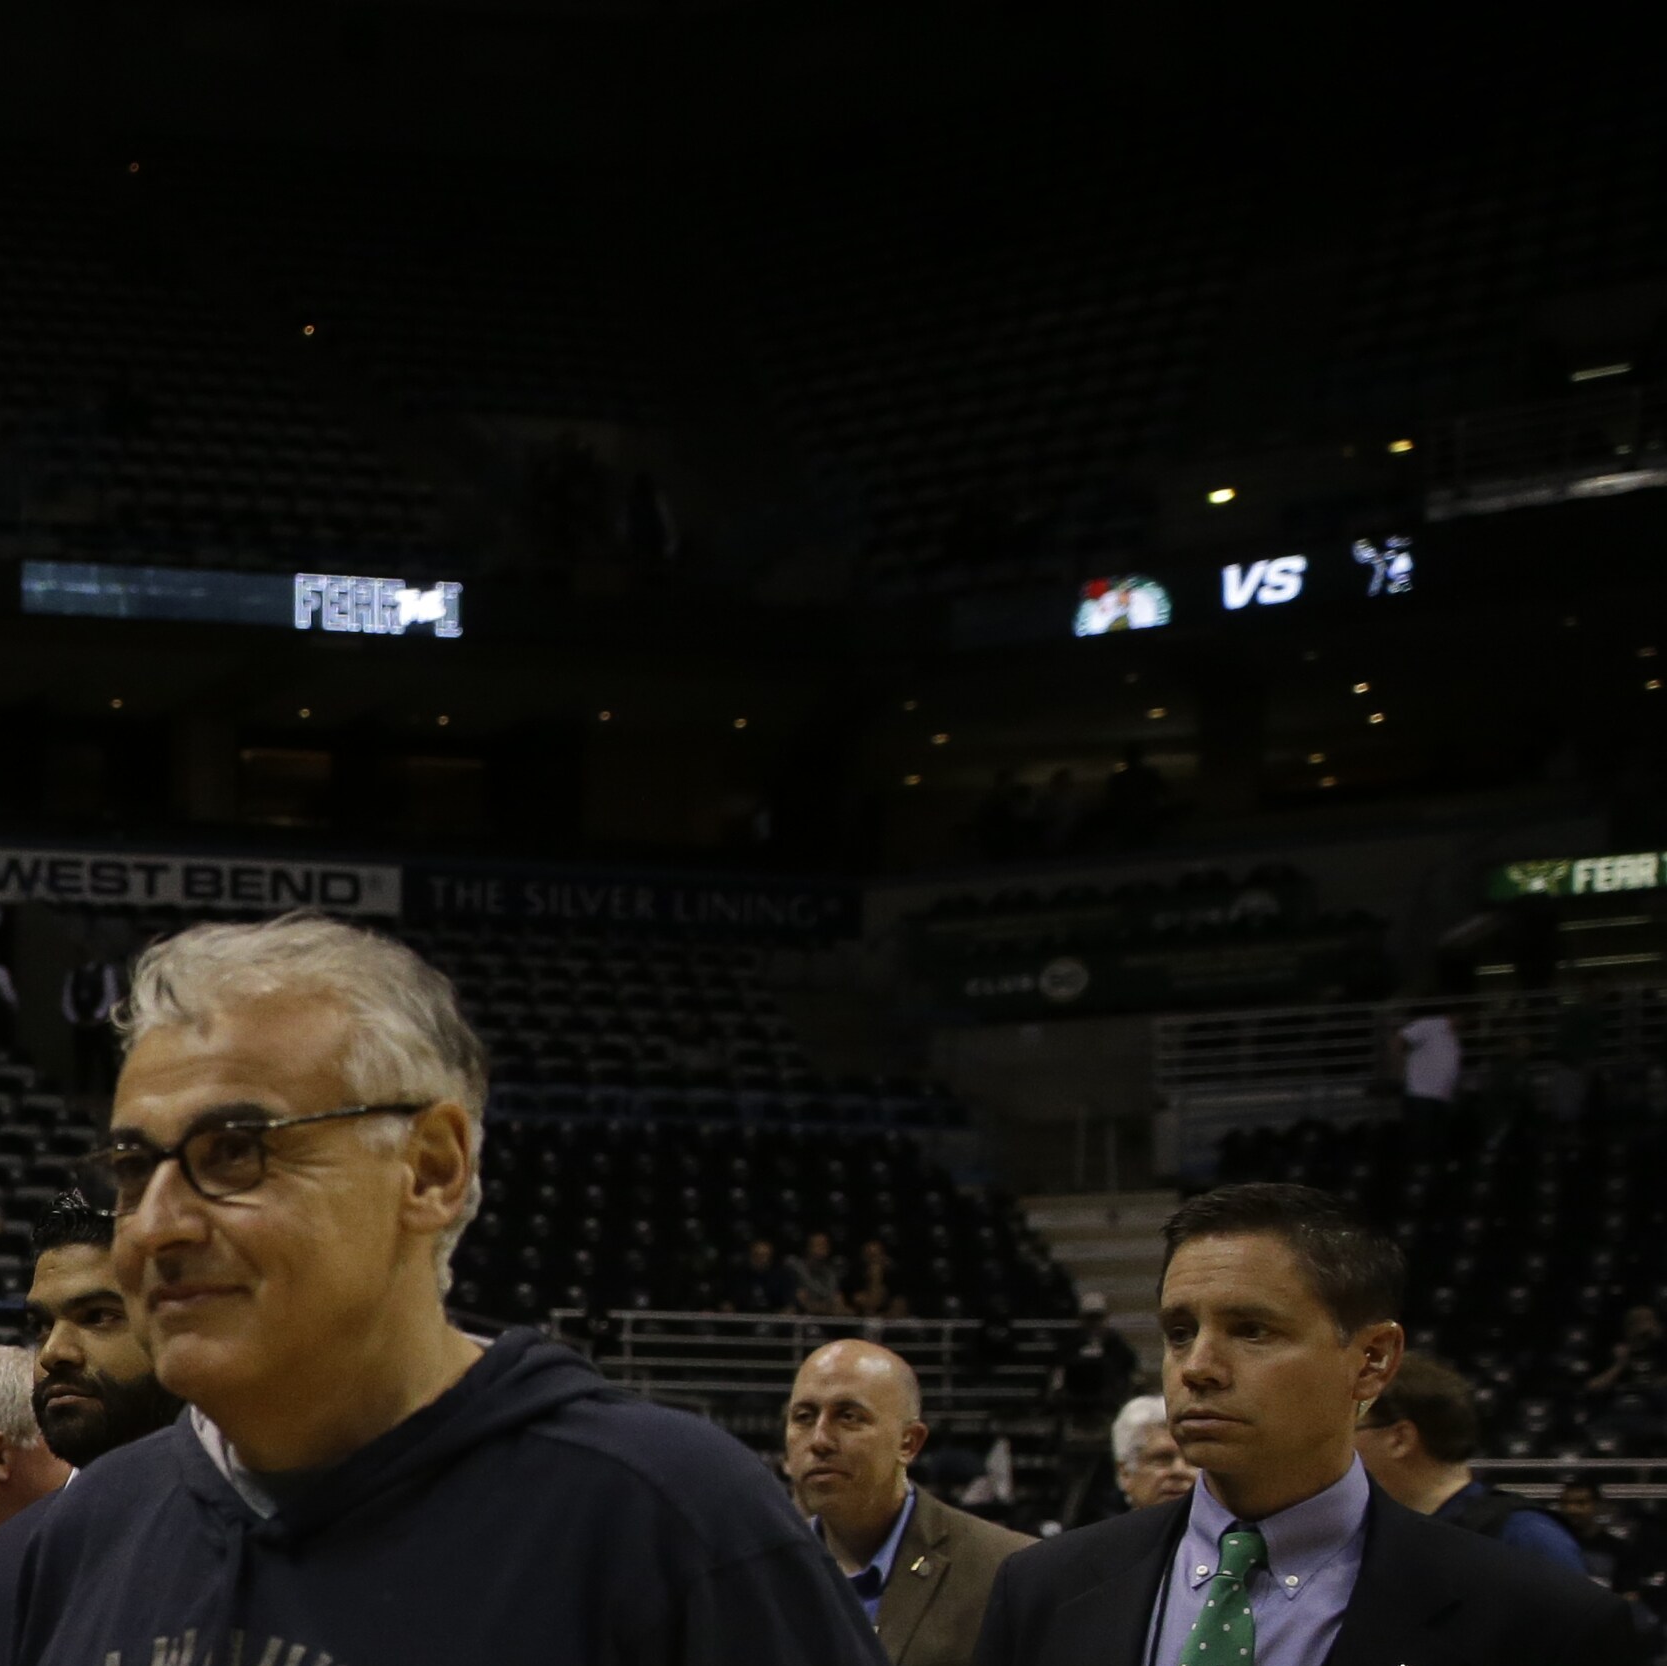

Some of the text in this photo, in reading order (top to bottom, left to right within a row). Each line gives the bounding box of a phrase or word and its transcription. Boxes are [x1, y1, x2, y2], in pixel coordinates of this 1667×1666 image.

[294, 572, 406, 635] FEAR
[1221, 553, 1308, 611] VS
[183, 864, 361, 905] BEND
[1572, 851, 1659, 894] FEAR
[427, 875, 820, 930] THE SILVER LINING
